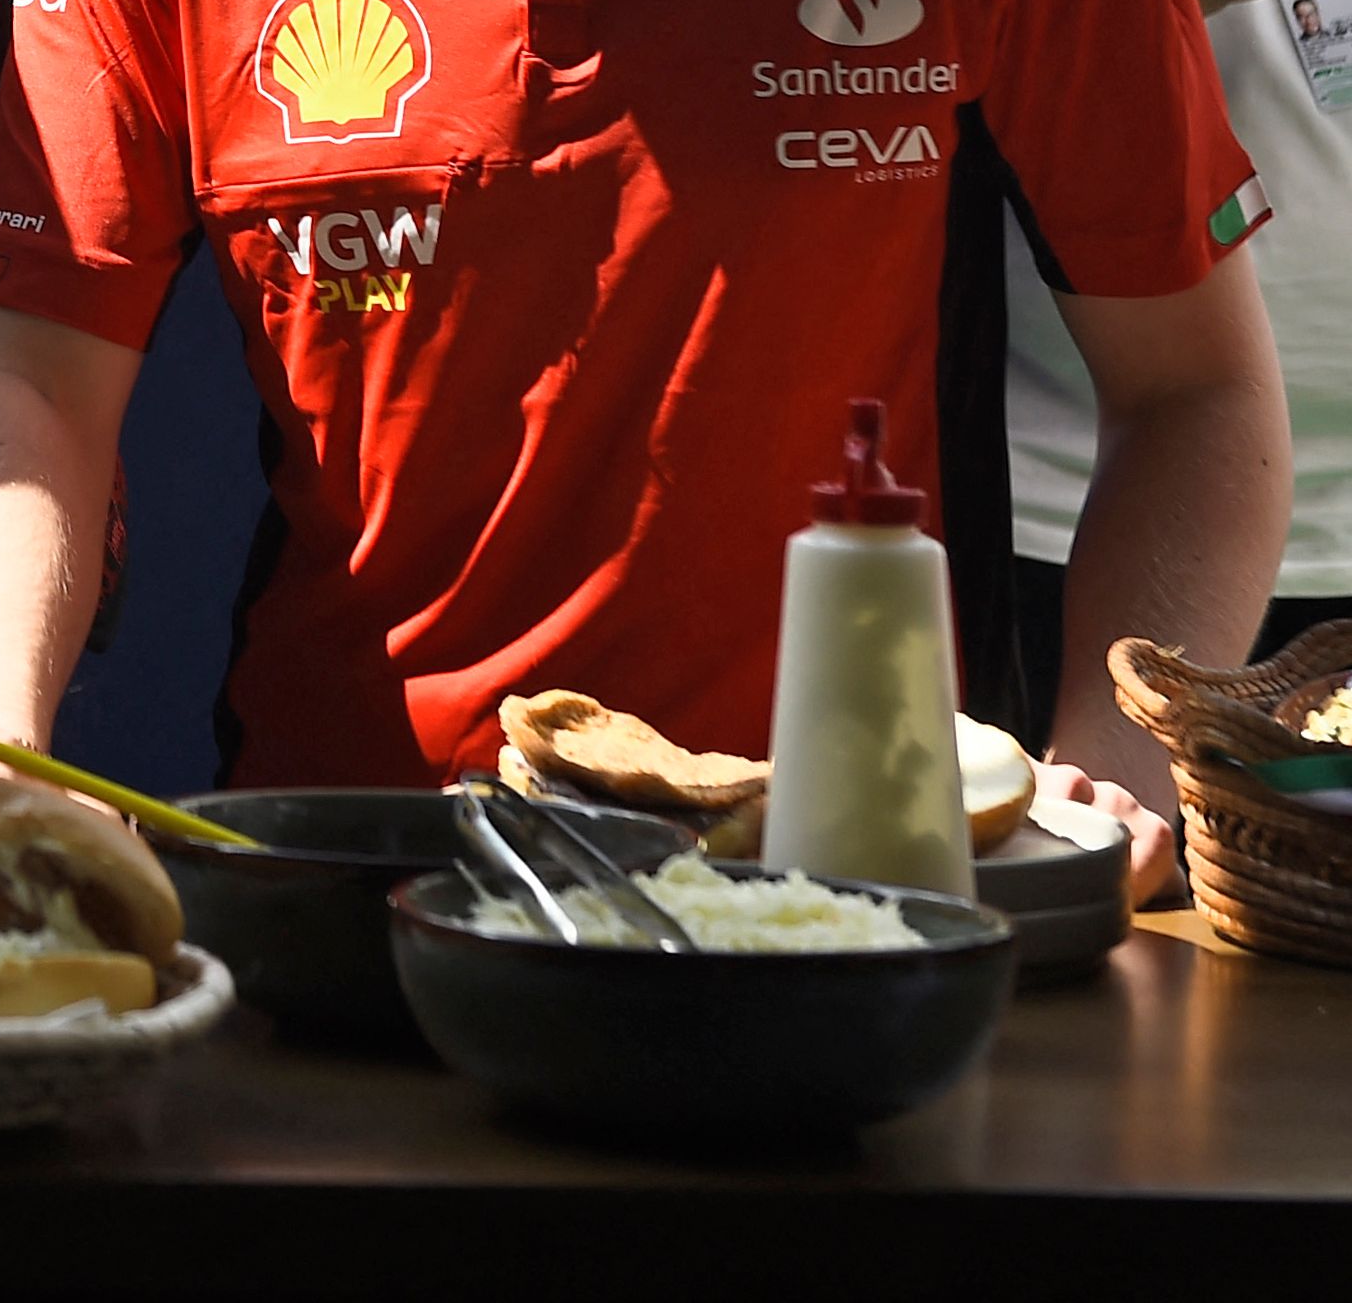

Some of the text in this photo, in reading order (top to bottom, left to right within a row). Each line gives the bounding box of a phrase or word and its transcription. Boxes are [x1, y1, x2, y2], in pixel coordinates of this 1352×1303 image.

[752, 57, 960, 97] Santander
[854, 165, 939, 184] LOGISTICS
[267, 203, 444, 276] VGW
[315, 272, 412, 313] PLAY
